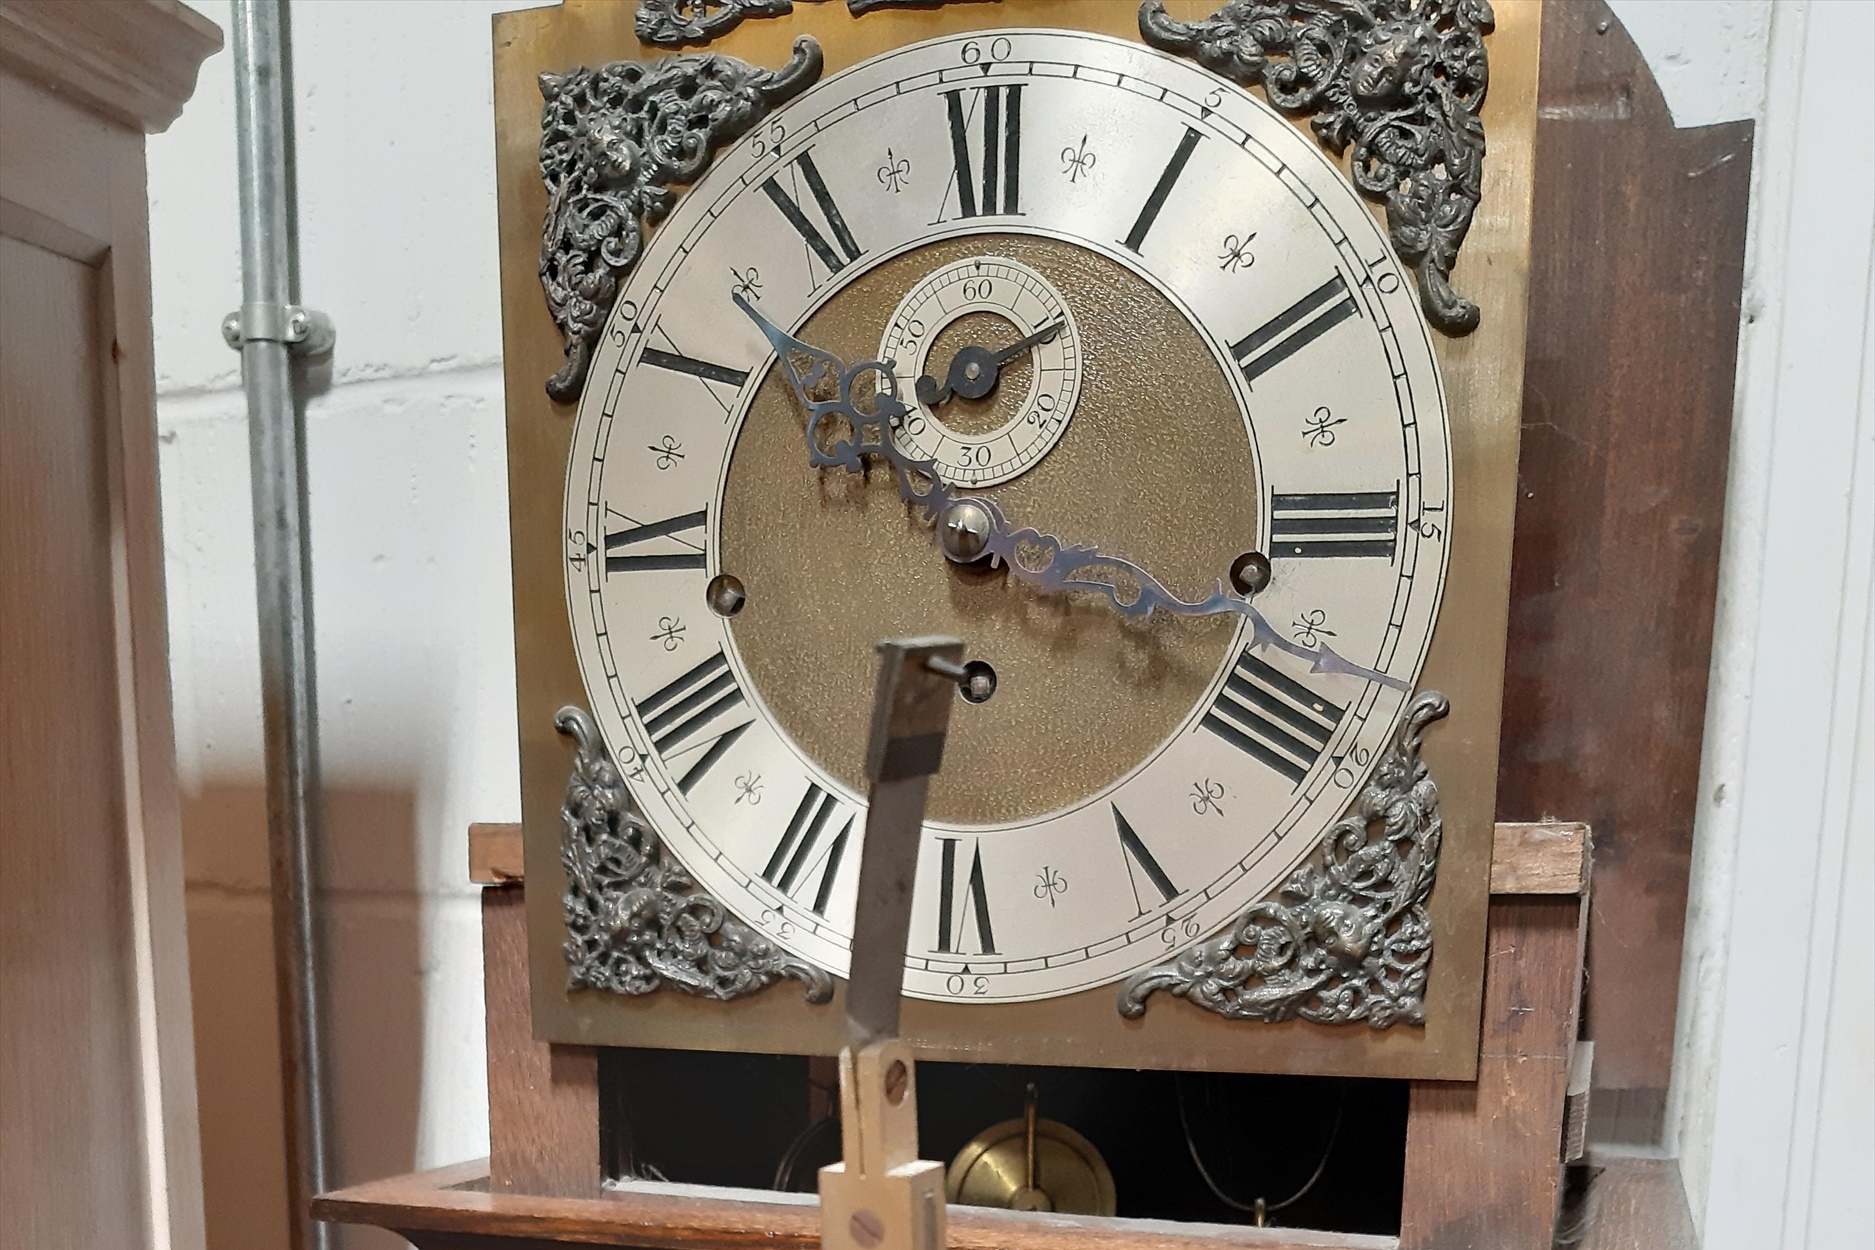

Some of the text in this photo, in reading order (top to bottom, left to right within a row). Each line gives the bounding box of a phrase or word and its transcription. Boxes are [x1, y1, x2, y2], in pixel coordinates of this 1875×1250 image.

[961, 37, 1012, 65] 60
[1203, 87, 1231, 109] 5
[750, 119, 786, 158] 55
[928, 83, 1029, 226] XII
[1115, 122, 1210, 257] I
[754, 144, 868, 298] XI
[963, 279, 992, 300] 60
[1364, 248, 1400, 295] 10
[609, 300, 639, 348] 50
[900, 319, 925, 356] 50
[1225, 266, 1363, 392] II
[637, 314, 753, 423] X
[1027, 393, 1056, 430] 20
[957, 446, 992, 467] 30
[605, 501, 708, 582] IX
[1270, 479, 1400, 566] III
[1420, 499, 1445, 544] 15
[569, 529, 587, 573] 45
[631, 641, 757, 802] VIII
[1193, 641, 1351, 796] IIII
[618, 744, 648, 784] 40
[1333, 742, 1370, 790] 20
[755, 776, 856, 921] VII
[1111, 801, 1189, 922] V
[928, 836, 1003, 956] VI
[754, 908, 797, 940] 35
[1160, 911, 1200, 948] 25
[946, 974, 991, 996] 30
